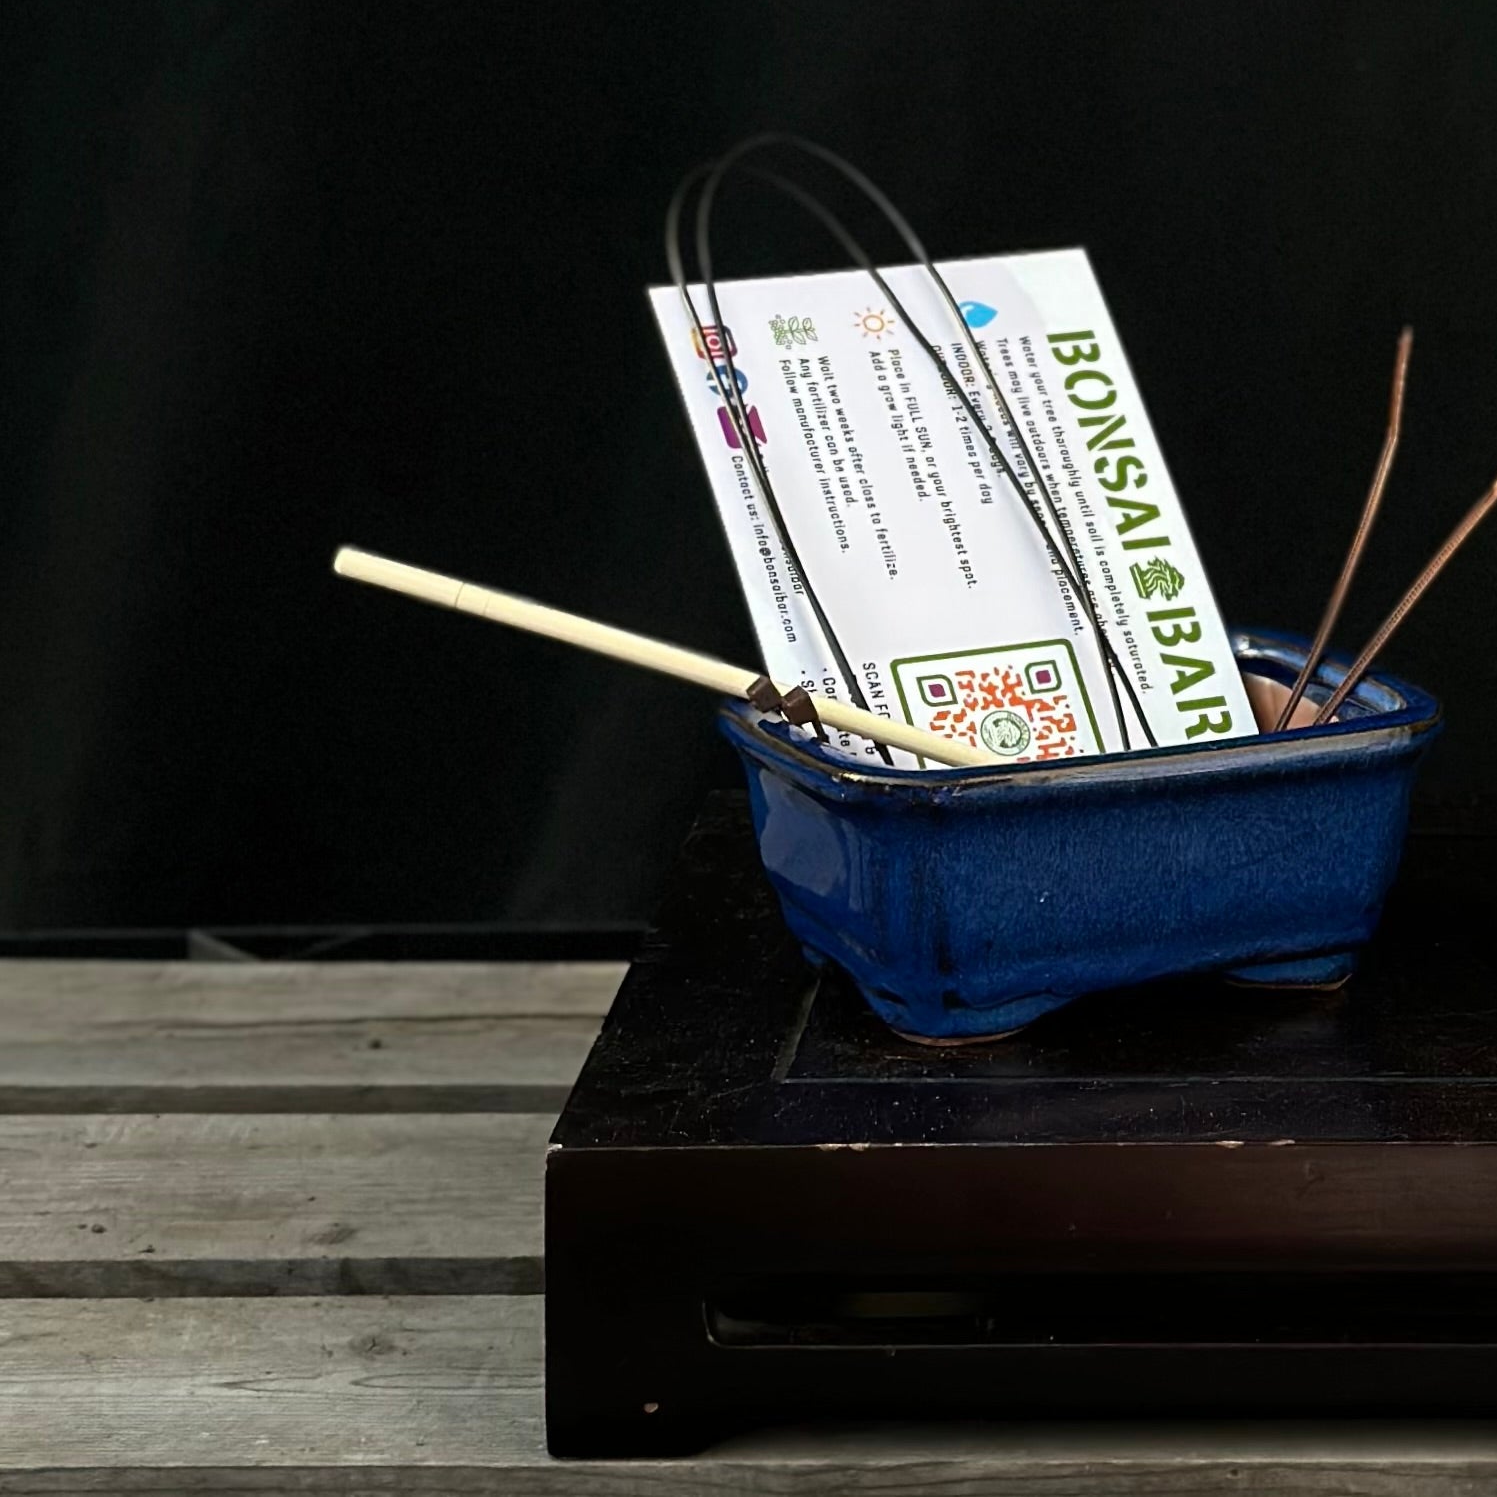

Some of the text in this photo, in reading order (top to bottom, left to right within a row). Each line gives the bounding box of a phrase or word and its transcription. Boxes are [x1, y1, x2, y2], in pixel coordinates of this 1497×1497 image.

[868, 351, 886, 370] Add
[950, 342, 975, 386] INDOOR:
[1018, 335, 1037, 367] Water
[877, 385, 896, 410] grow
[1028, 371, 1048, 395] your
[890, 414, 908, 441] light
[951, 403, 967, 422] 1-2
[996, 337, 1013, 367] Trees
[1007, 370, 1022, 393] may
[1016, 396, 1031, 416] live
[1025, 420, 1050, 469] outdoors
[1045, 473, 1062, 503] when
[1042, 399, 1057, 422] tree
[798, 358, 858, 506] Any fertilizer can be used.
[901, 444, 915, 452] if
[959, 425, 976, 457] times
[778, 359, 849, 553] Follow manufacturer instructions.
[817, 355, 897, 579] Wait two weeks after class to fertilize.
[887, 348, 977, 588] Place in FULL SUN, or your brightest spot.
[967, 461, 984, 479] per
[1051, 425, 1081, 487] thoroughly
[905, 457, 931, 501] needed.
[978, 483, 993, 504] day
[1074, 490, 1094, 517] until
[1014, 451, 1029, 477] vary
[1023, 481, 1037, 495] by
[1050, 567, 1083, 635] placement.
[1046, 329, 1232, 739] BONSAI BAR
[1085, 521, 1103, 541] soil
[731, 455, 796, 642] Contact us: info@bonsaibar.com
[1093, 546, 1104, 556] is
[1099, 560, 1129, 626] completely
[1122, 630, 1153, 693] saturated.
[862, 662, 884, 698] SCAN
